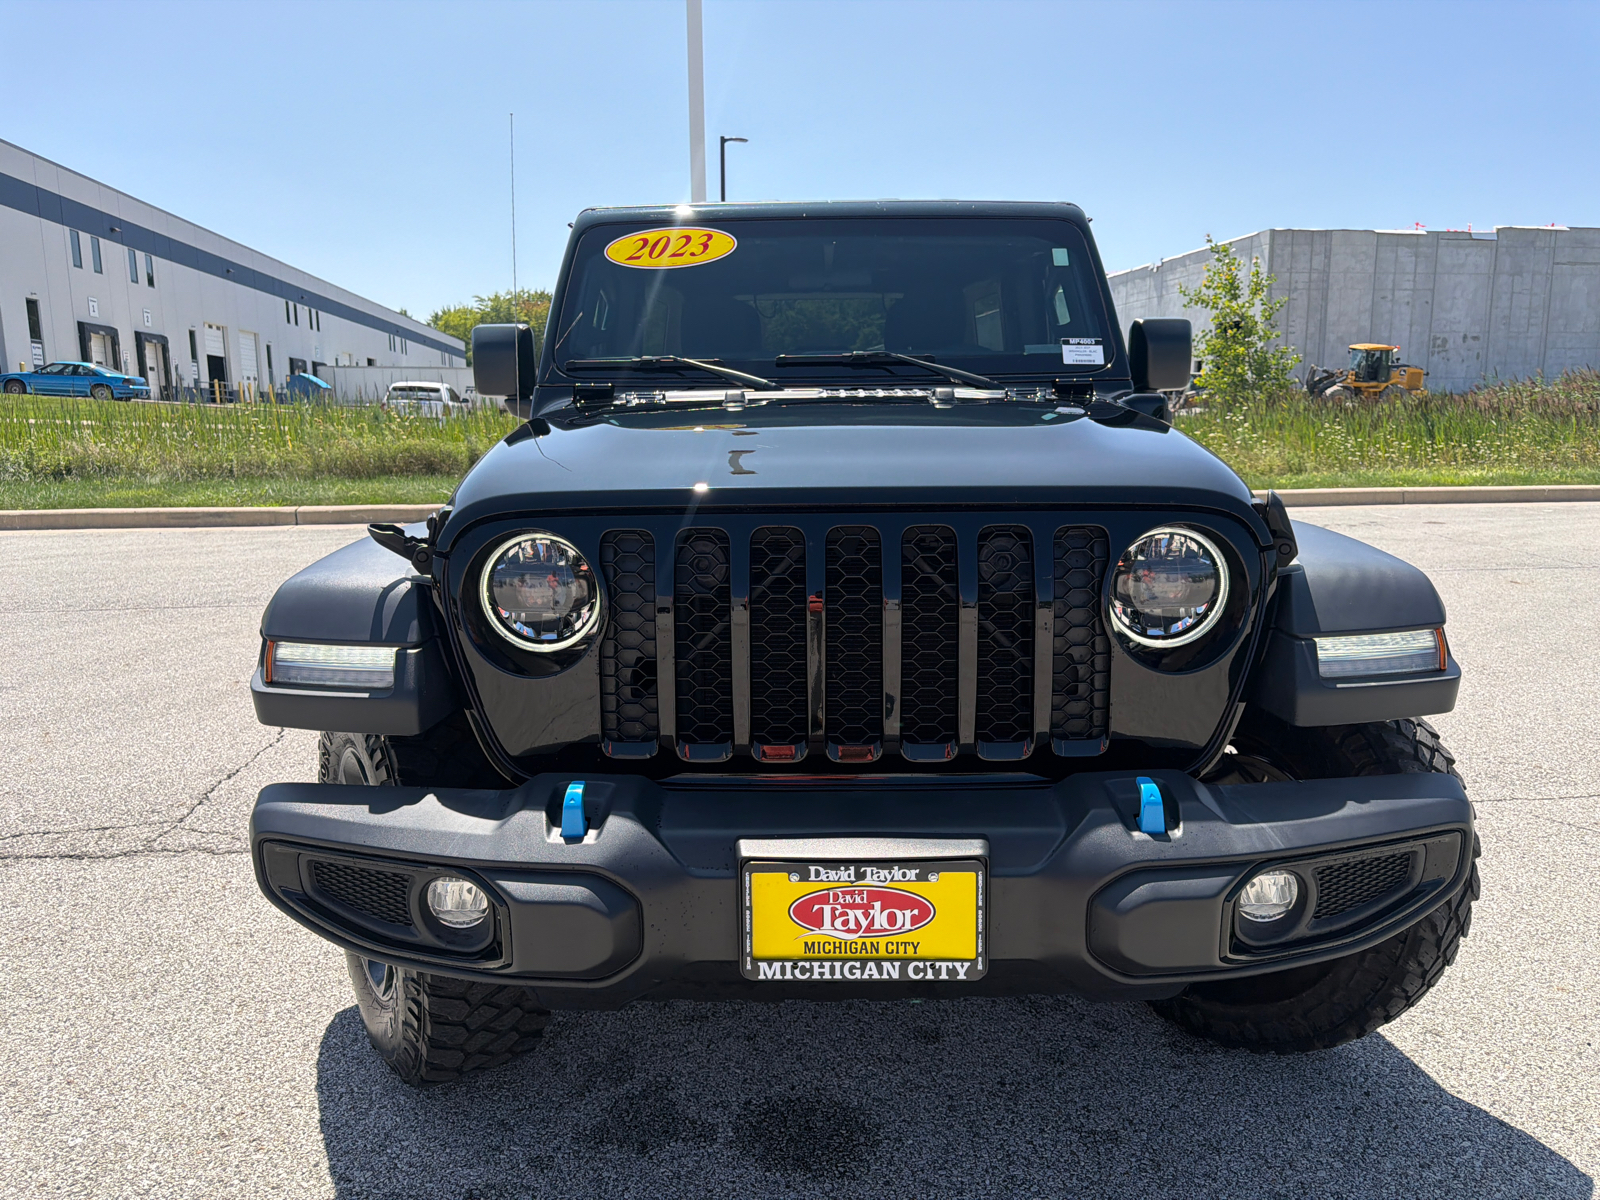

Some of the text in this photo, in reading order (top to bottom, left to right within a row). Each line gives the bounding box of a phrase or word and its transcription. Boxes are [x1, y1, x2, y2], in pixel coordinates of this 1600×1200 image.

[624, 233, 714, 261] 2023
[808, 865, 920, 887] David Taylor
[828, 890, 868, 905] David
[795, 901, 919, 940] Taylor
[803, 941, 921, 955] MICHIGAN CITY
[758, 961, 971, 980] MICHIGAN CITY
